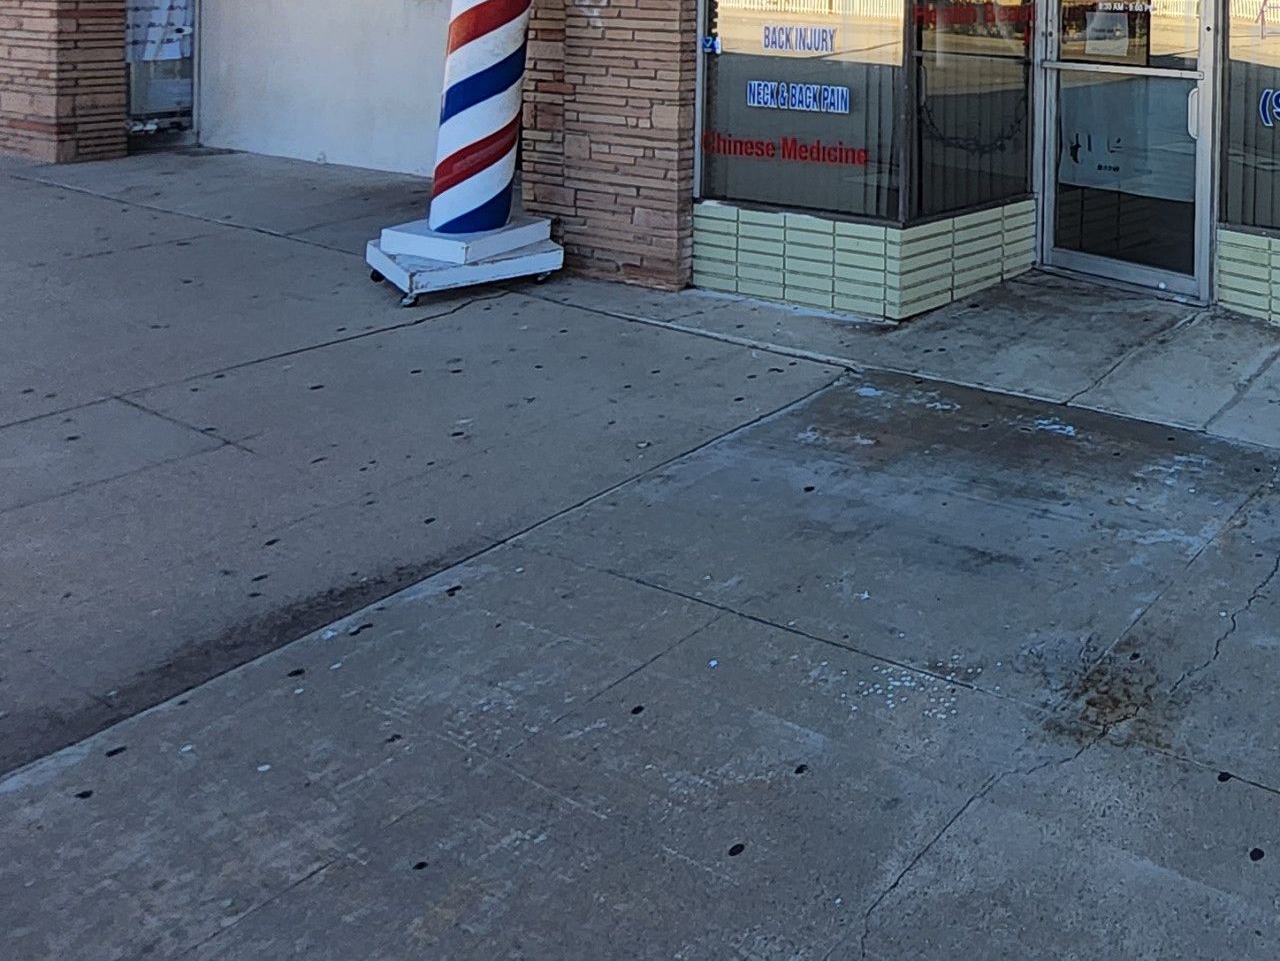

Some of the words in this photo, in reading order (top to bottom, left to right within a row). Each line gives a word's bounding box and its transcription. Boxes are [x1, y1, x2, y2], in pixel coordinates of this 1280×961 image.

[763, 26, 793, 50] BACK
[794, 28, 837, 52] INJURY
[748, 81, 777, 108] NECK
[778, 82, 789, 109] &
[790, 84, 820, 110] BACK
[821, 87, 850, 114] PAIN
[703, 132, 776, 159] Chinese
[781, 137, 868, 166] Medicine
